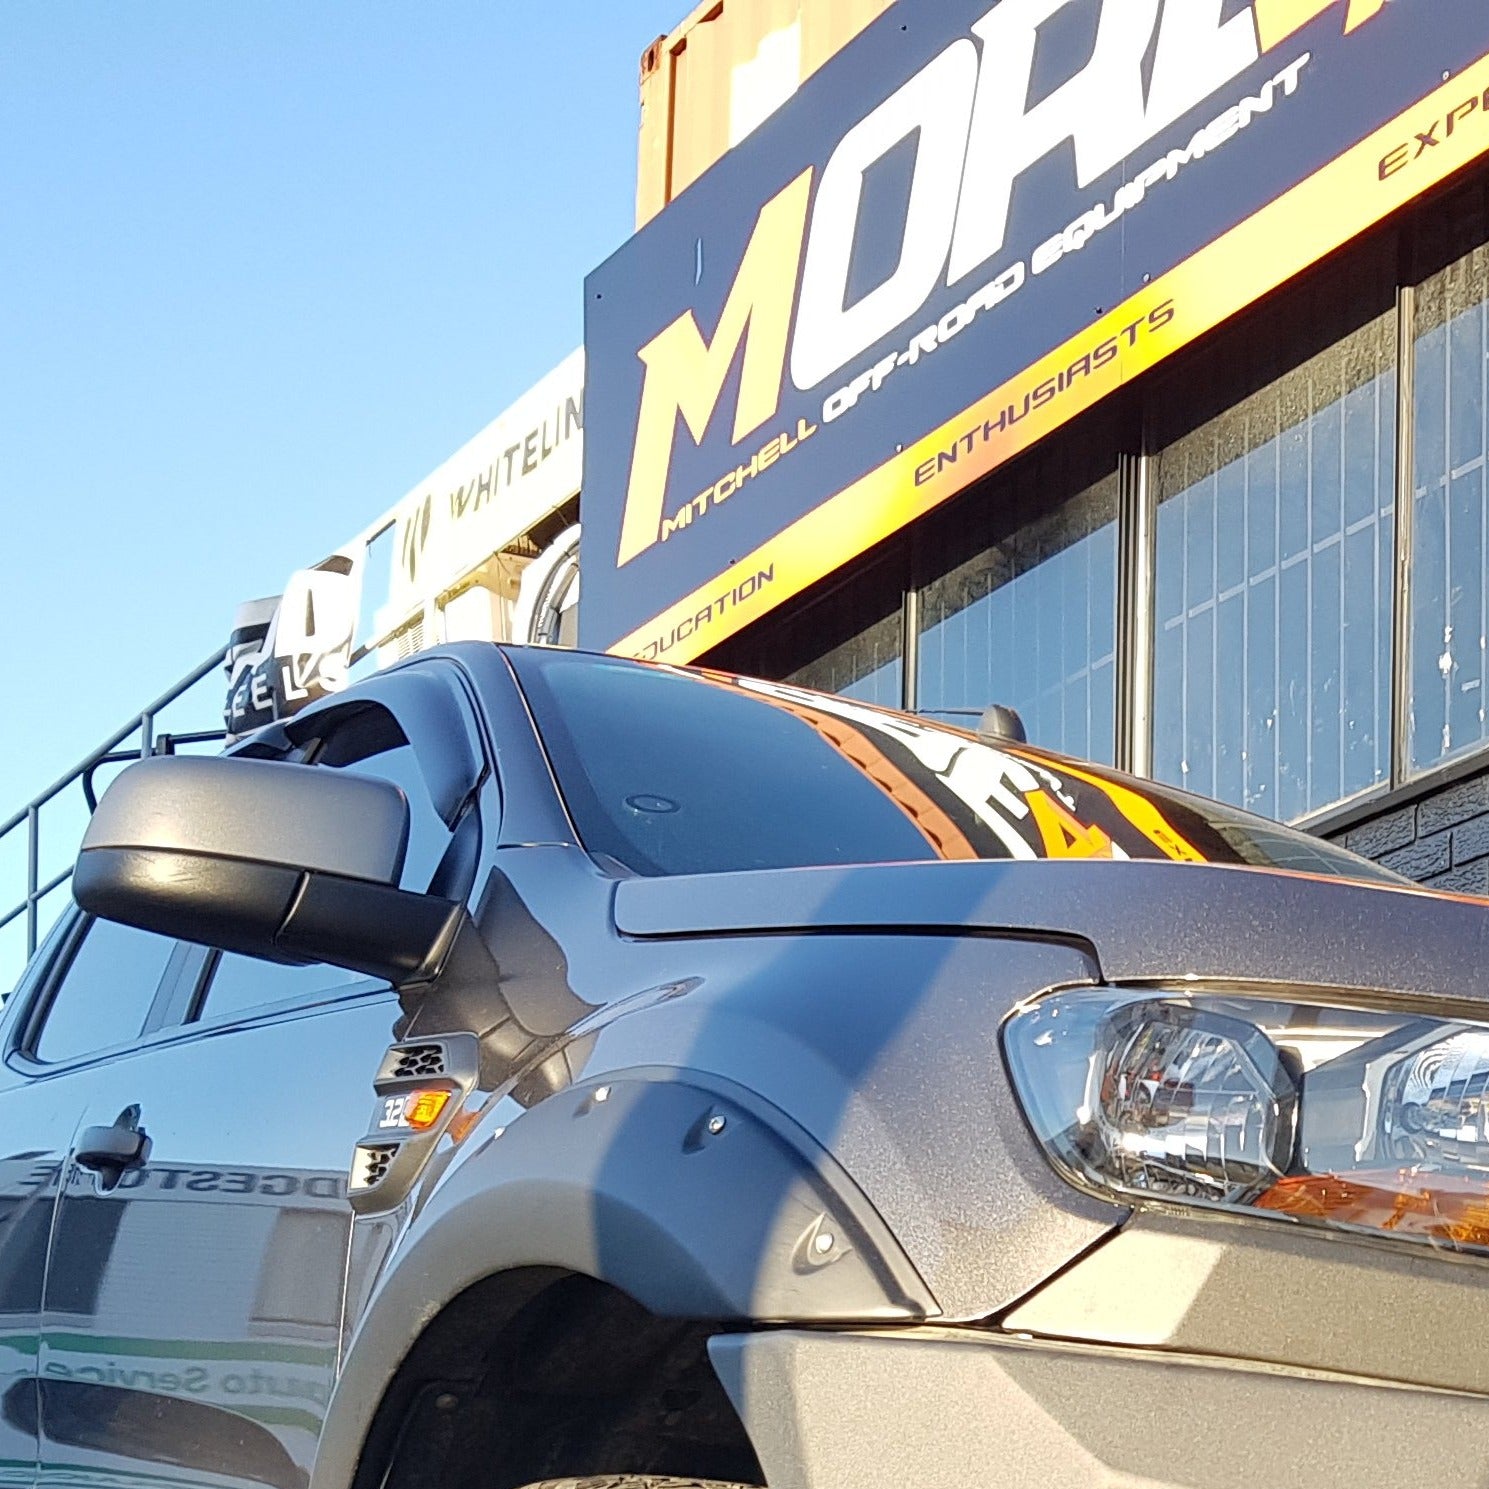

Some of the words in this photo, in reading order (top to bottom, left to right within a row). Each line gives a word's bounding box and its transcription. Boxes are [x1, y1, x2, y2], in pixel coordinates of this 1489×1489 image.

[661, 418, 817, 542] MITCHELL
[821, 260, 1026, 425] OFF-ROAD
[1031, 51, 1311, 276] EQUIPMENT
[914, 299, 1175, 487] ENTHUSIASTS
[633, 562, 774, 661] DUCATION
